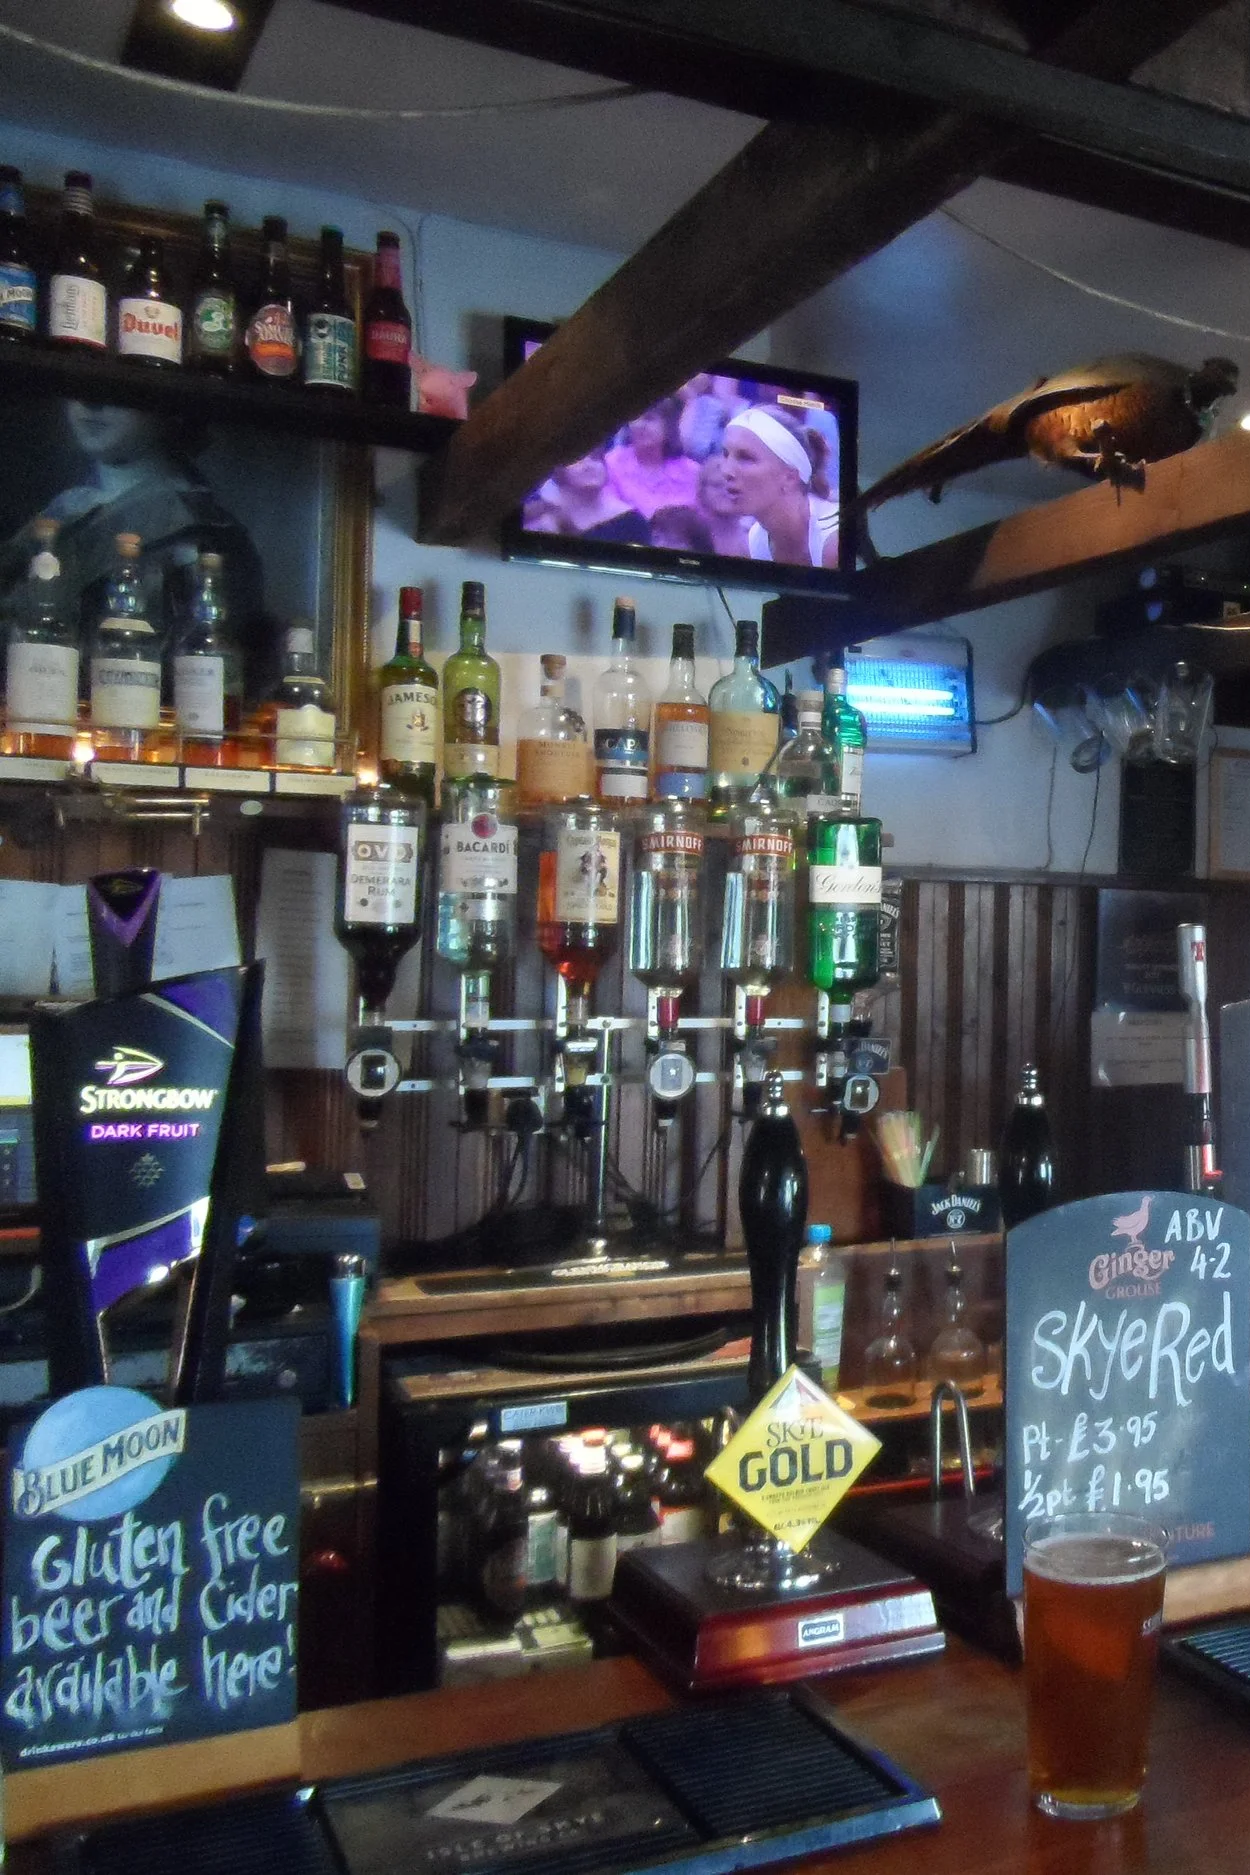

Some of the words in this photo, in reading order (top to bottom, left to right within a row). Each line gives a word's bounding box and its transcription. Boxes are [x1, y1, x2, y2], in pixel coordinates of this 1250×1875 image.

[123, 312, 179, 342] Duvel
[641, 834, 703, 850] SMIRNOFF
[735, 835, 793, 853] SMIRNOFF
[350, 873, 412, 887] DEMERARA
[367, 885, 397, 898] RUM
[815, 873, 882, 895] Gordon's
[80, 1085, 214, 1114] STRONGBOW
[91, 1123, 144, 1139] DARK
[147, 1123, 200, 1138] FRUIT
[931, 1198, 952, 1215] JACK
[1164, 1207, 1224, 1244] ABV
[1088, 1244, 1175, 1291] Ginger
[1105, 1281, 1162, 1300] GROUSE
[22, 1455, 97, 1516] BLUE
[101, 1415, 181, 1477] MOON
[738, 1437, 853, 1493] GOLD
[31, 1510, 191, 1591] Gluten
[201, 1492, 290, 1588] free
[12, 1594, 125, 1655] beer
[125, 1576, 184, 1635] and
[200, 1563, 300, 1632] Cider
[802, 1621, 841, 1638] ANGRAM
[5, 1643, 189, 1730] available
